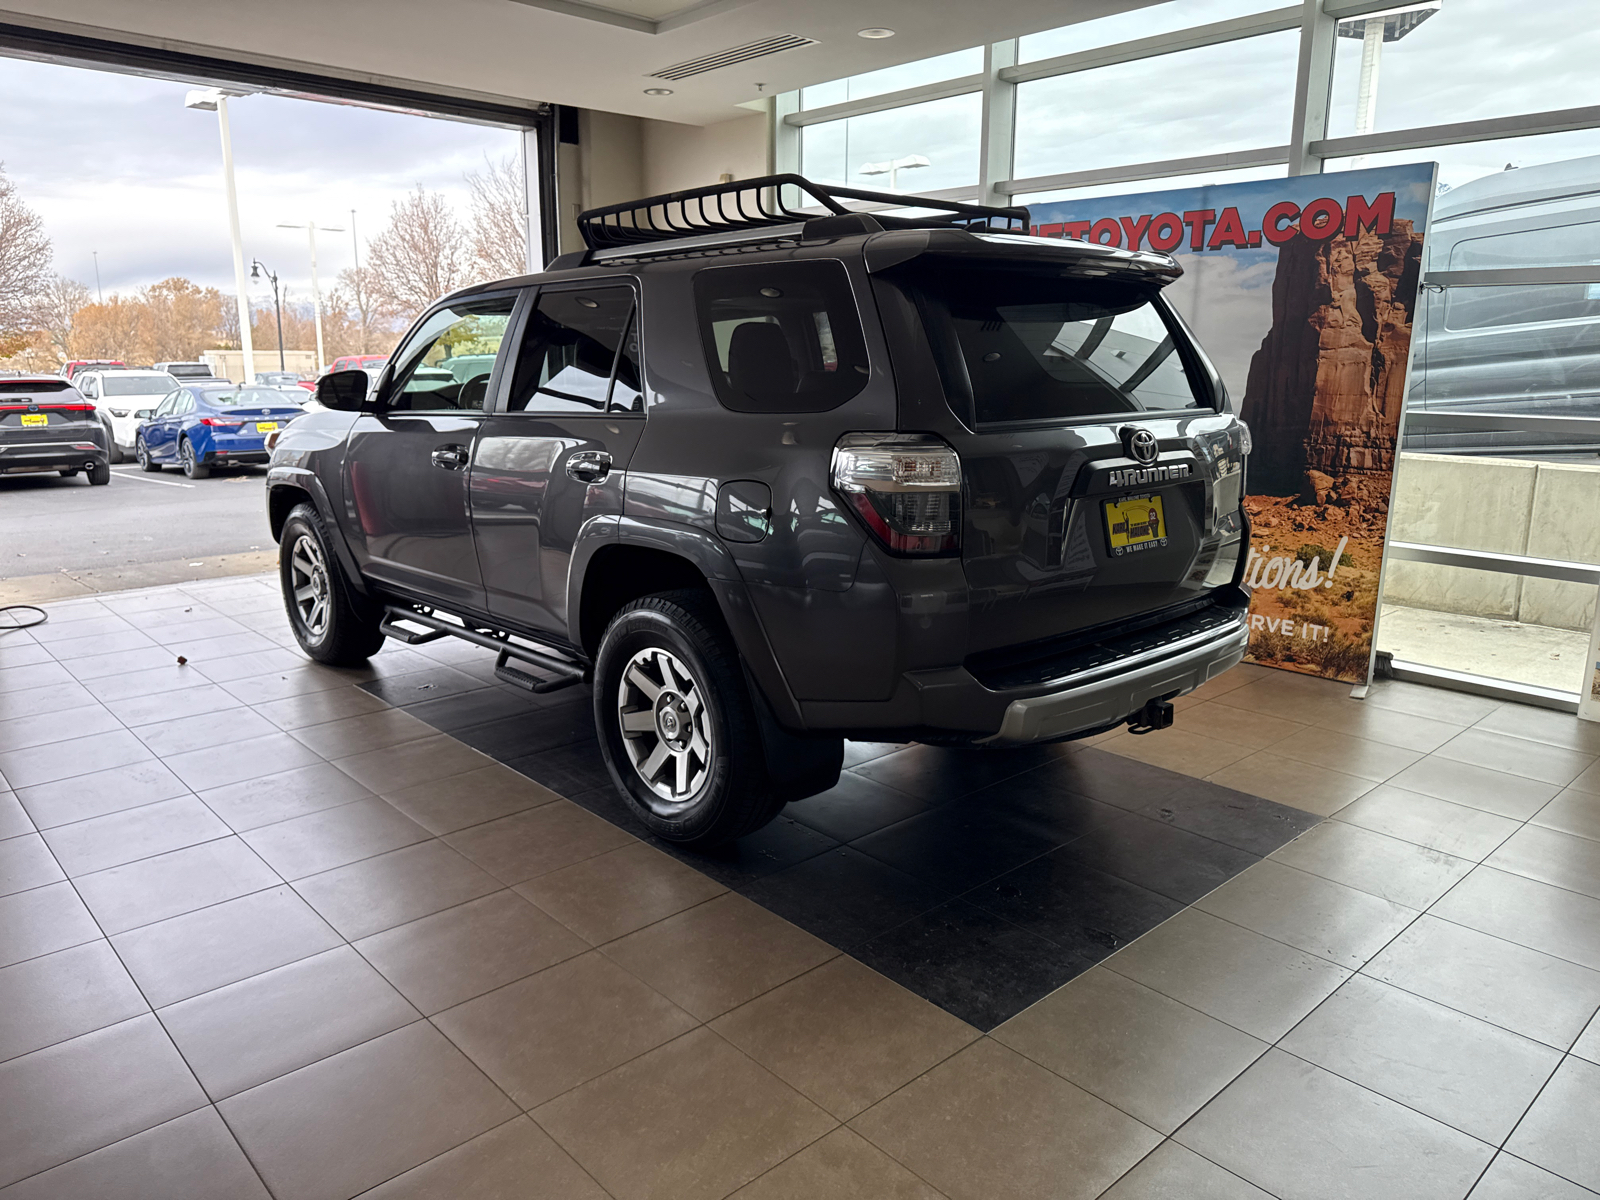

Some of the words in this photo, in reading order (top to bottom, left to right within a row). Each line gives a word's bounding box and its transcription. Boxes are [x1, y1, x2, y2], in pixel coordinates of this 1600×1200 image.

[1126, 545, 1133, 553] WE
[1133, 543, 1144, 552] MAKE
[1148, 540, 1158, 549] EASY
[1247, 613, 1295, 637] RVE
[1301, 622, 1330, 643] IT!
